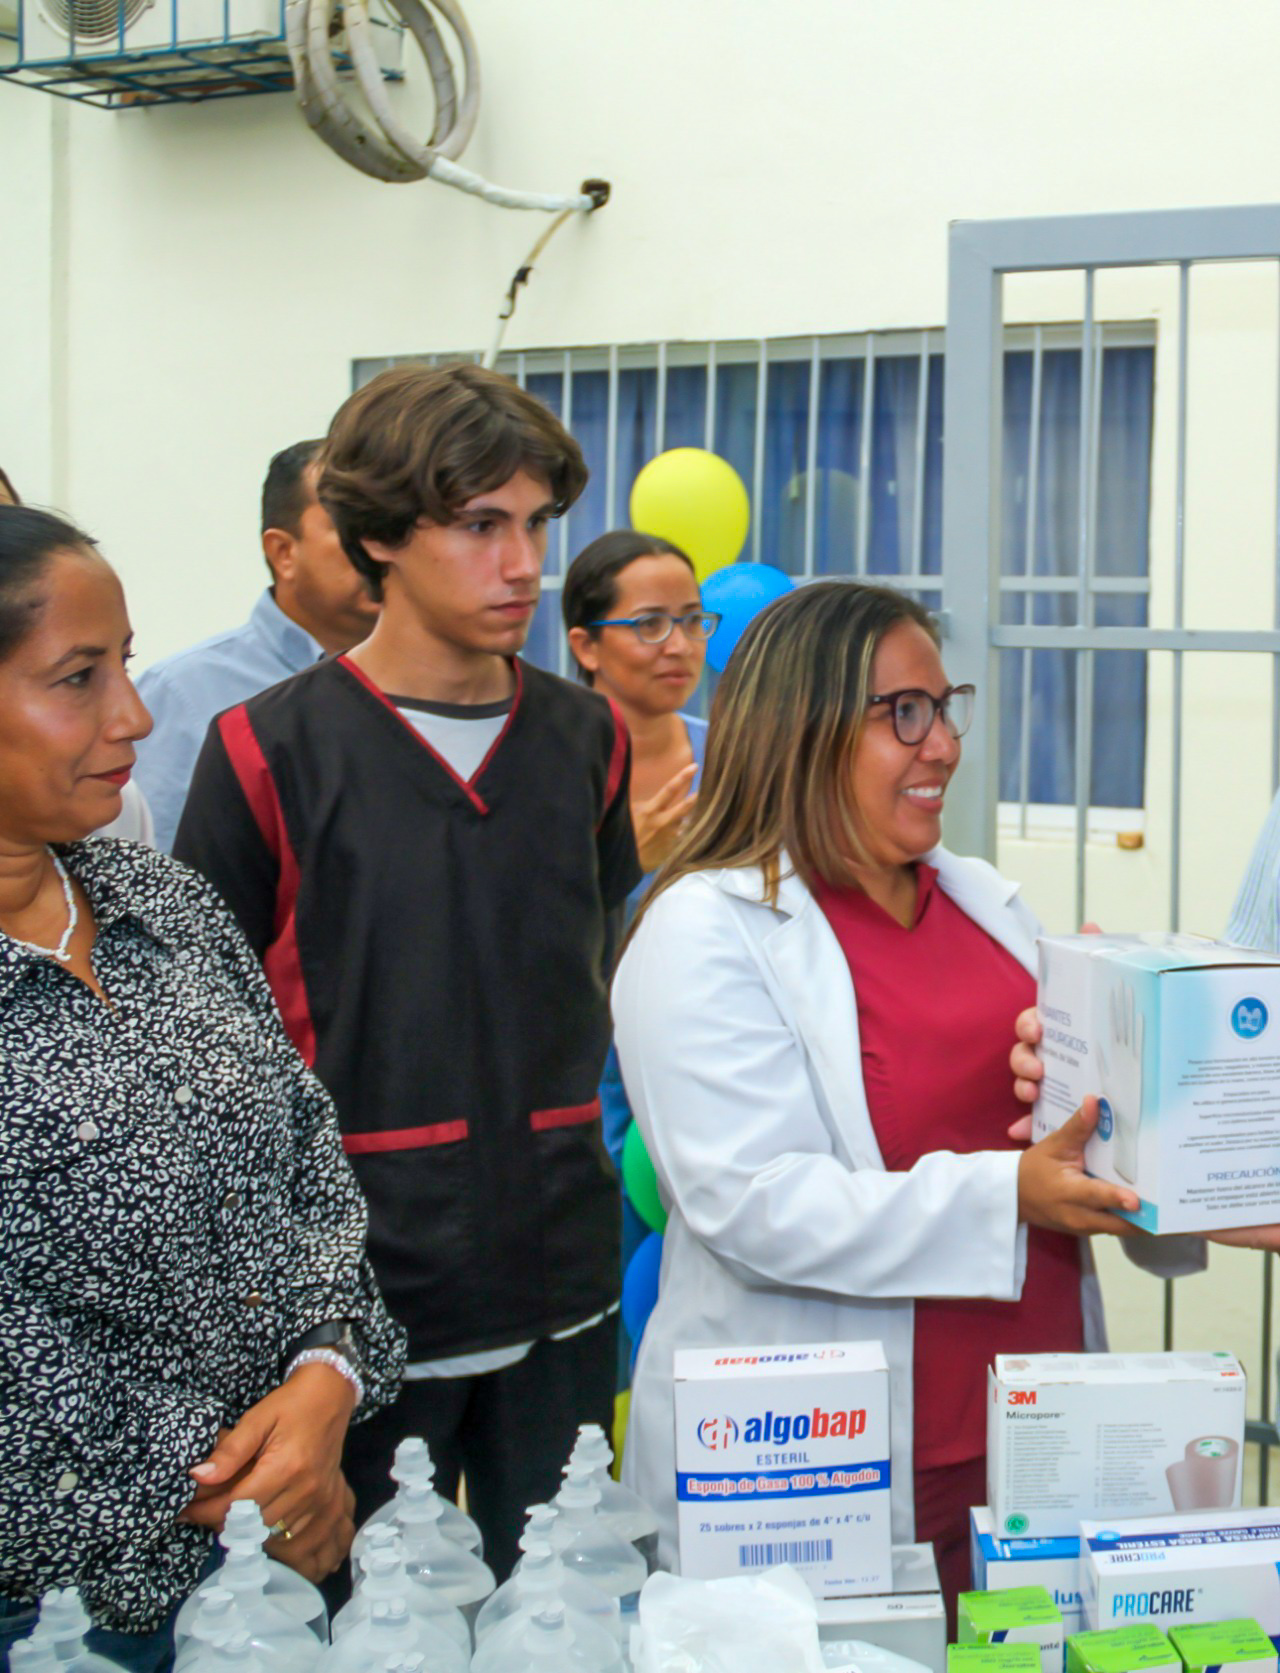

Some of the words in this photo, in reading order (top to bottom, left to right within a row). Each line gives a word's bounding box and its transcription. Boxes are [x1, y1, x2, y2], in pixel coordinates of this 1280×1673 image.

[1007, 1391, 1037, 1405] 3M
[1006, 1411, 1061, 1421] Micropore
[744, 1408, 867, 1445] algobap
[756, 1452, 811, 1466] ESTERIL
[687, 1477, 737, 1497] Esponja
[738, 1478, 756, 1492] de
[757, 1477, 788, 1492] Gasa
[790, 1474, 814, 1488] 100
[831, 1467, 881, 1487] Algodón
[700, 1522, 711, 1532] 25
[714, 1521, 745, 1532] sobres
[756, 1521, 763, 1530] 2
[765, 1517, 806, 1531] esponjas
[810, 1516, 821, 1527] de
[1112, 1589, 1195, 1617] PROCARE
